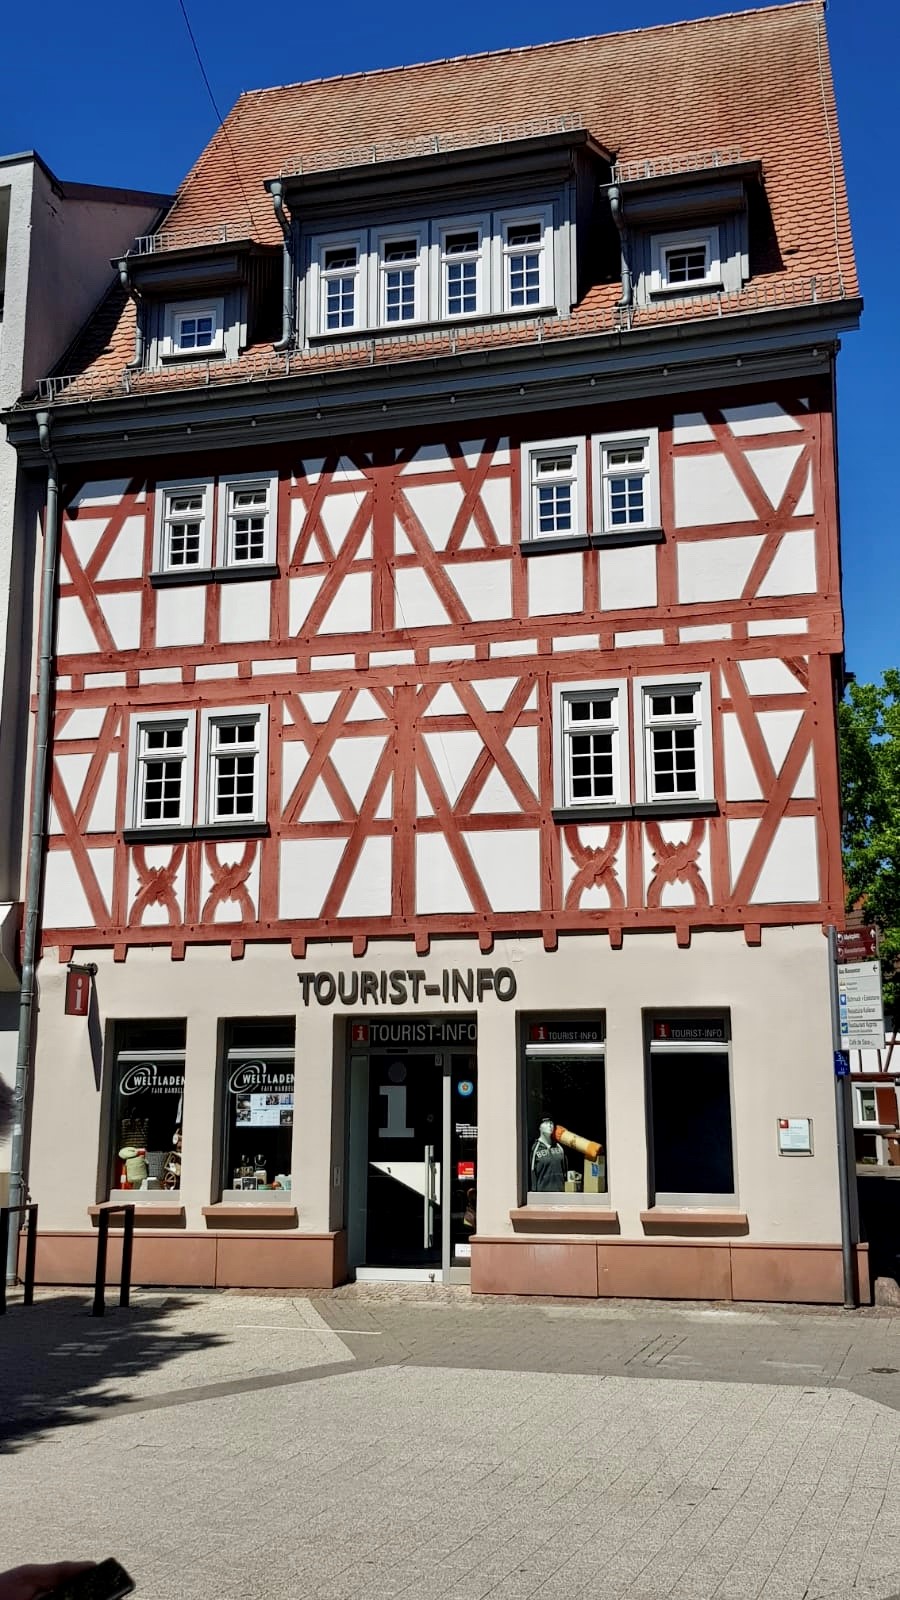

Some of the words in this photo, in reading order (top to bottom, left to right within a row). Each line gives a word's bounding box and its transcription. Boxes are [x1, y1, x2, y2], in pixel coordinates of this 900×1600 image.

[297, 967, 517, 1007] TOURIST-INFO
[369, 1023, 478, 1042] TOURIST-INFO
[548, 1031, 598, 1040] TOURIST-INFO
[671, 1029, 722, 1038] TOURIST-INFO
[133, 1075, 186, 1086] WELTLADEN
[242, 1073, 295, 1085] WELTLADEN
